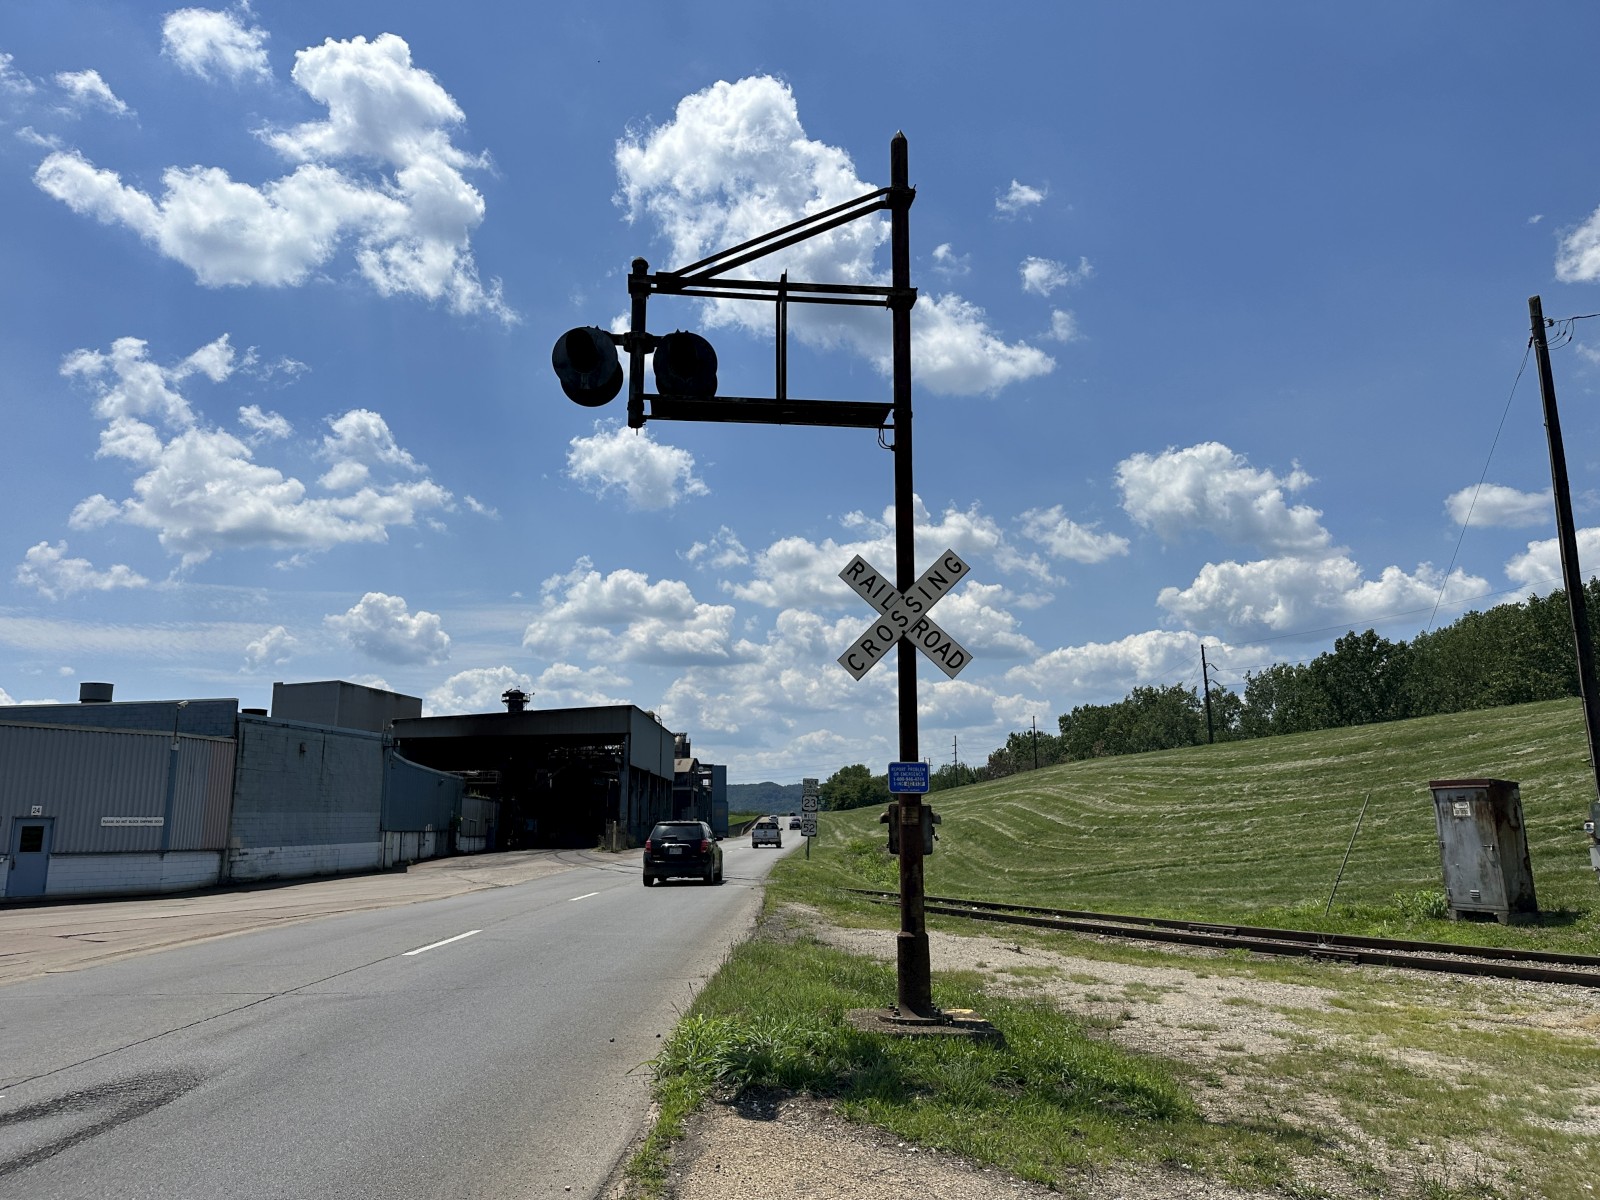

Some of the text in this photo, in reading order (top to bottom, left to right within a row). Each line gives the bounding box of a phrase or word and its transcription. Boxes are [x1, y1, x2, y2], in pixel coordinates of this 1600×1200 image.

[847, 557, 962, 671] CROSSING
[804, 798, 816, 808] 23
[803, 824, 815, 833] 52
